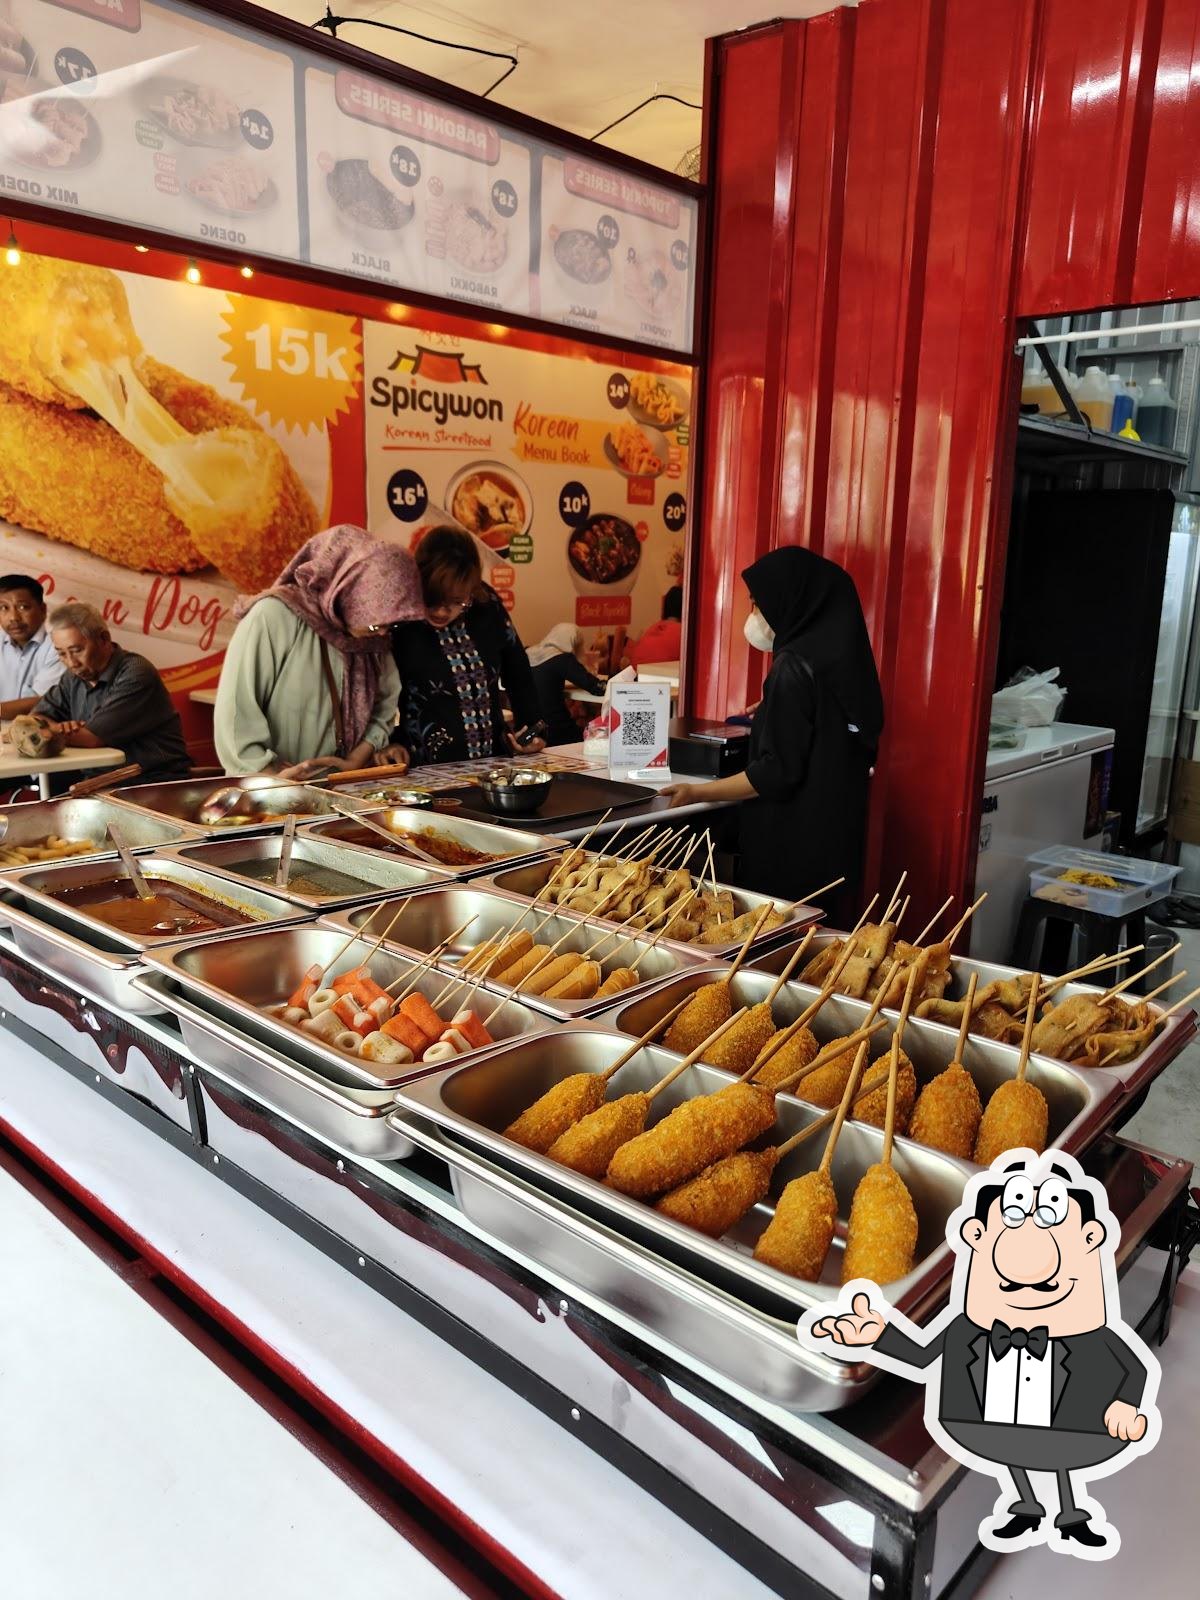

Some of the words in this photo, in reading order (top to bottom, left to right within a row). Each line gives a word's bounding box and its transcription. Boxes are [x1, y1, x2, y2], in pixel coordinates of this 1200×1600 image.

[246, 323, 349, 382] 15k
[370, 376, 504, 425] Spicywon
[384, 424, 430, 442] Korean
[513, 401, 579, 442] Korean
[523, 441, 558, 461] Menu
[561, 446, 591, 465] Book
[392, 483, 426, 507] 16k
[563, 493, 588, 514] 10k
[665, 503, 686, 519] 20k
[142, 576, 230, 651] Dog
